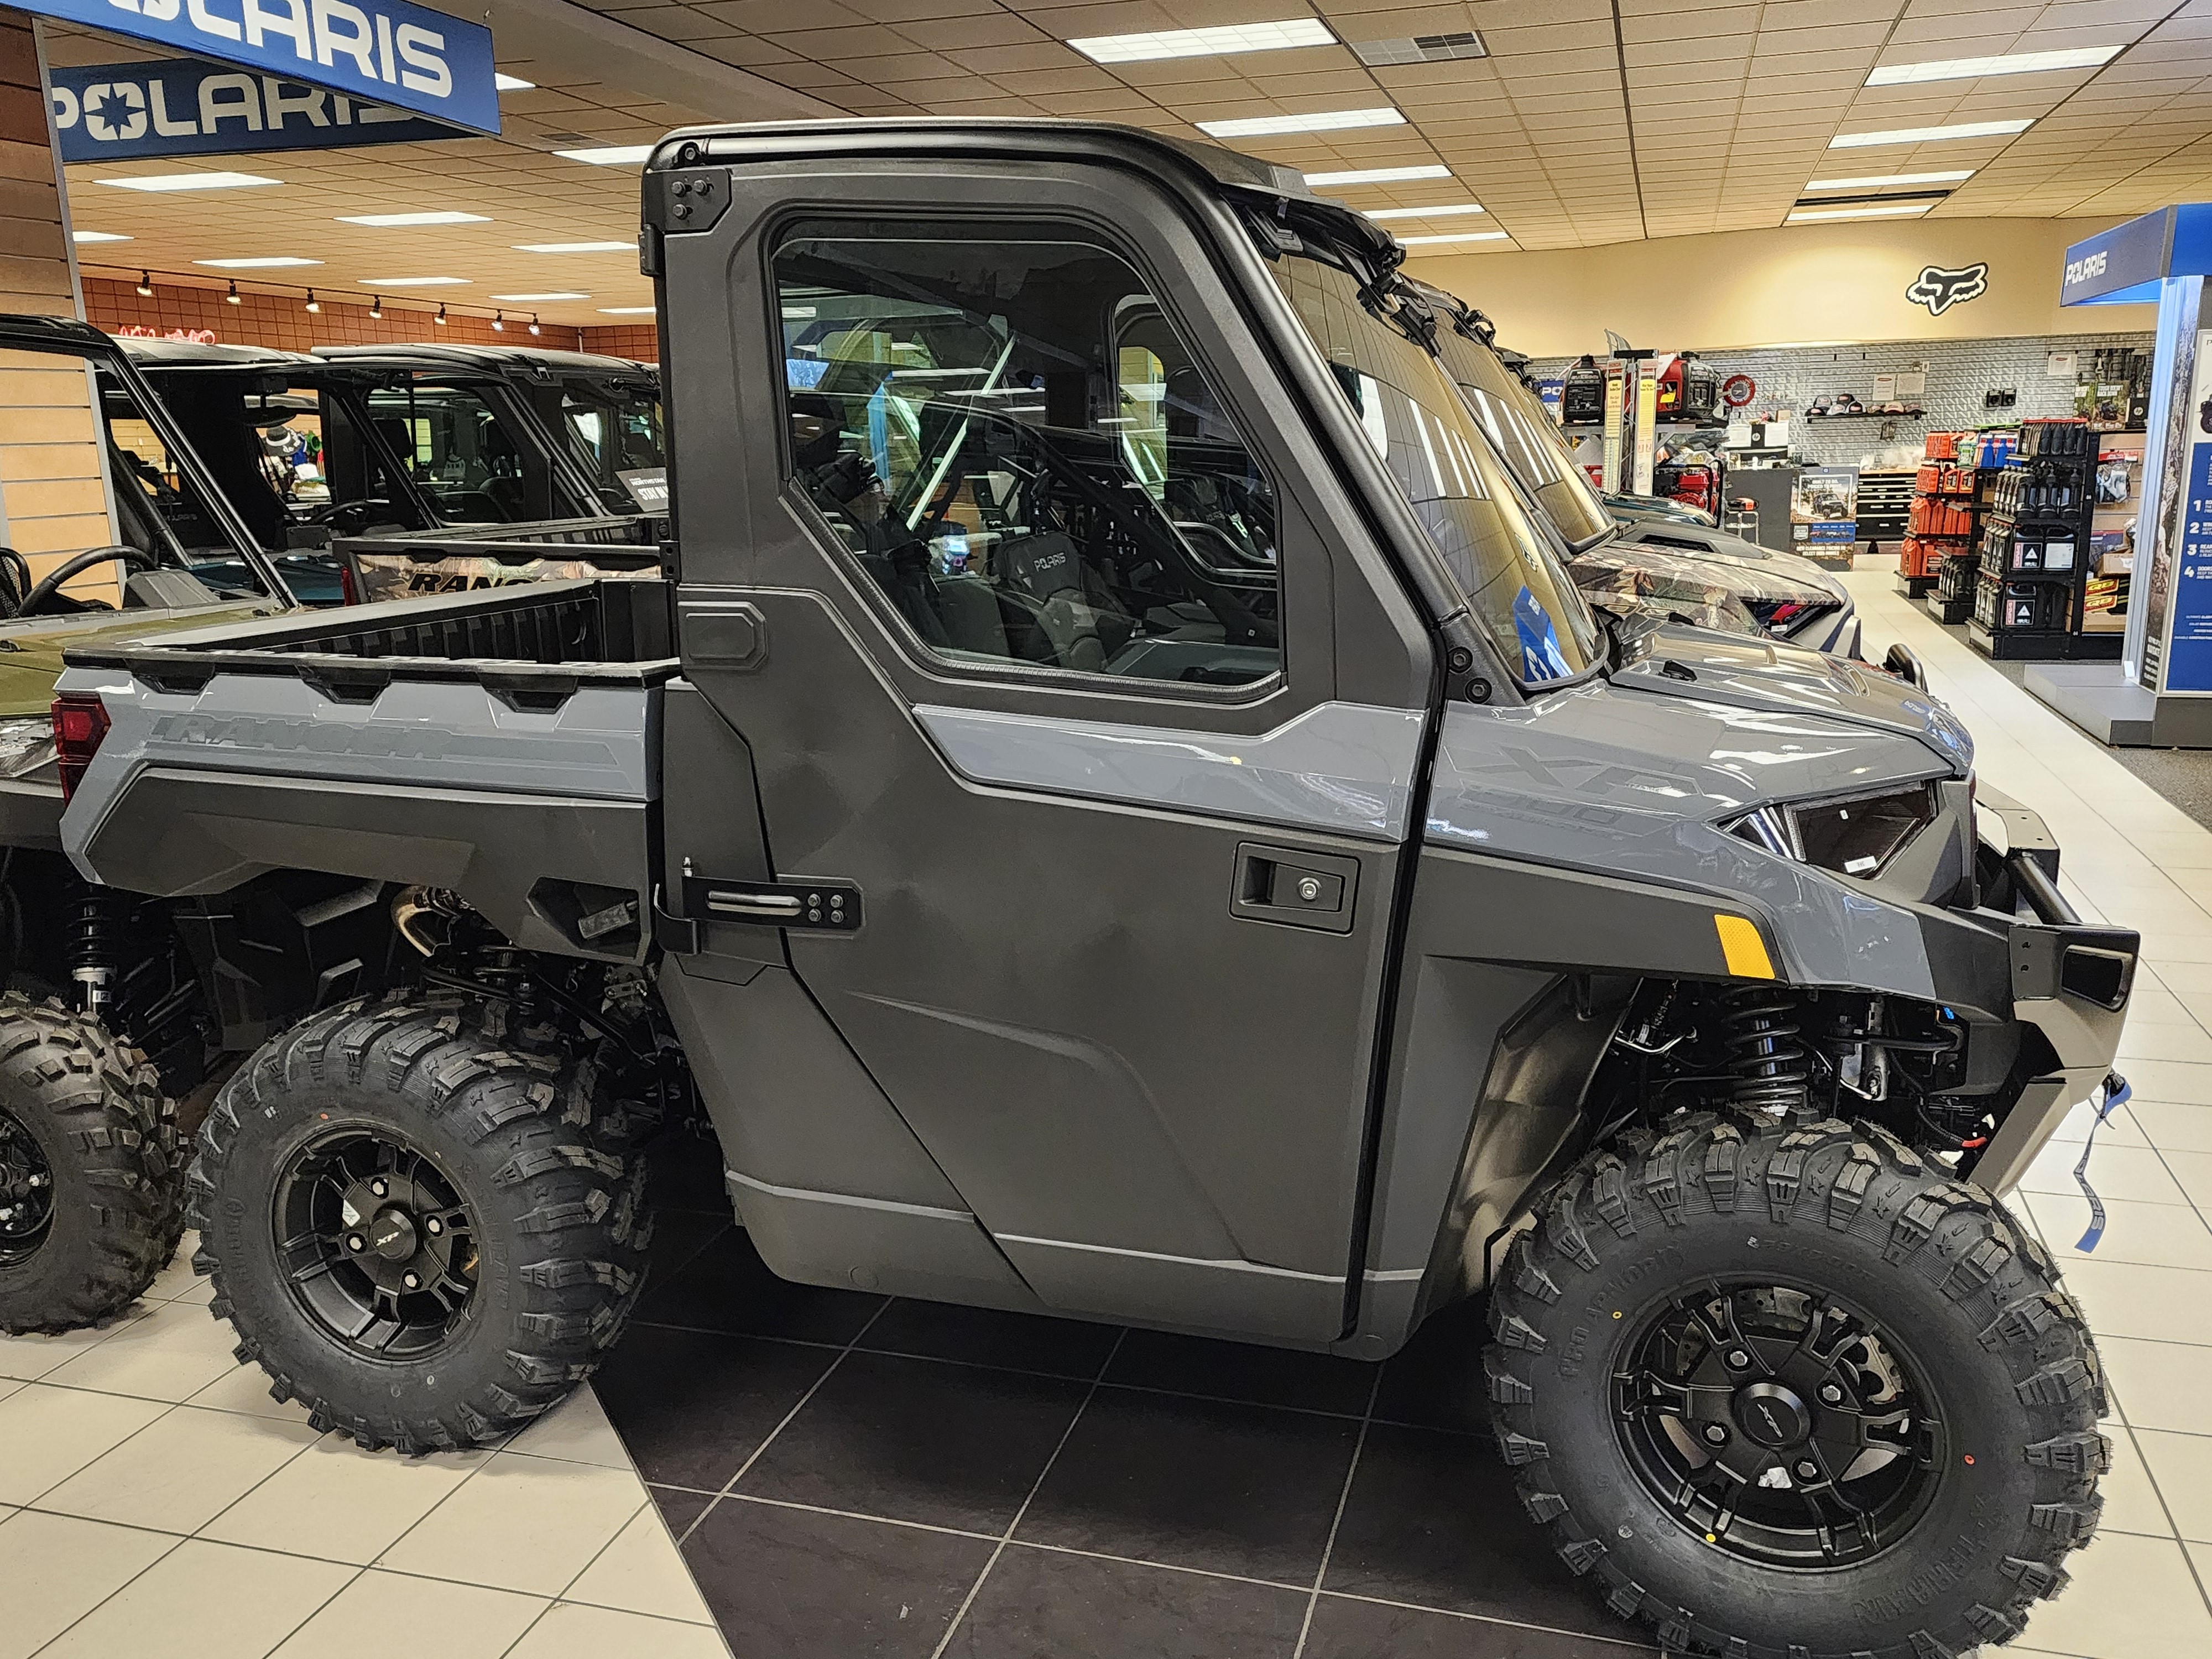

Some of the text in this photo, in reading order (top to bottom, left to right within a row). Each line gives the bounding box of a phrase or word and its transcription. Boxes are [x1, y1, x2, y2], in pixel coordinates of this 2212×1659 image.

[2064, 251, 2107, 287] POLARIS
[2193, 499, 2201, 512] 1
[2189, 521, 2200, 534] 2
[2187, 544, 2197, 556] 3
[1034, 552, 1066, 572] POLARIS
[2184, 566, 2195, 578] 4
[408, 573, 534, 592] RAN
[376, 1232, 399, 1246] XP
[1757, 1403, 1783, 1438] XP
